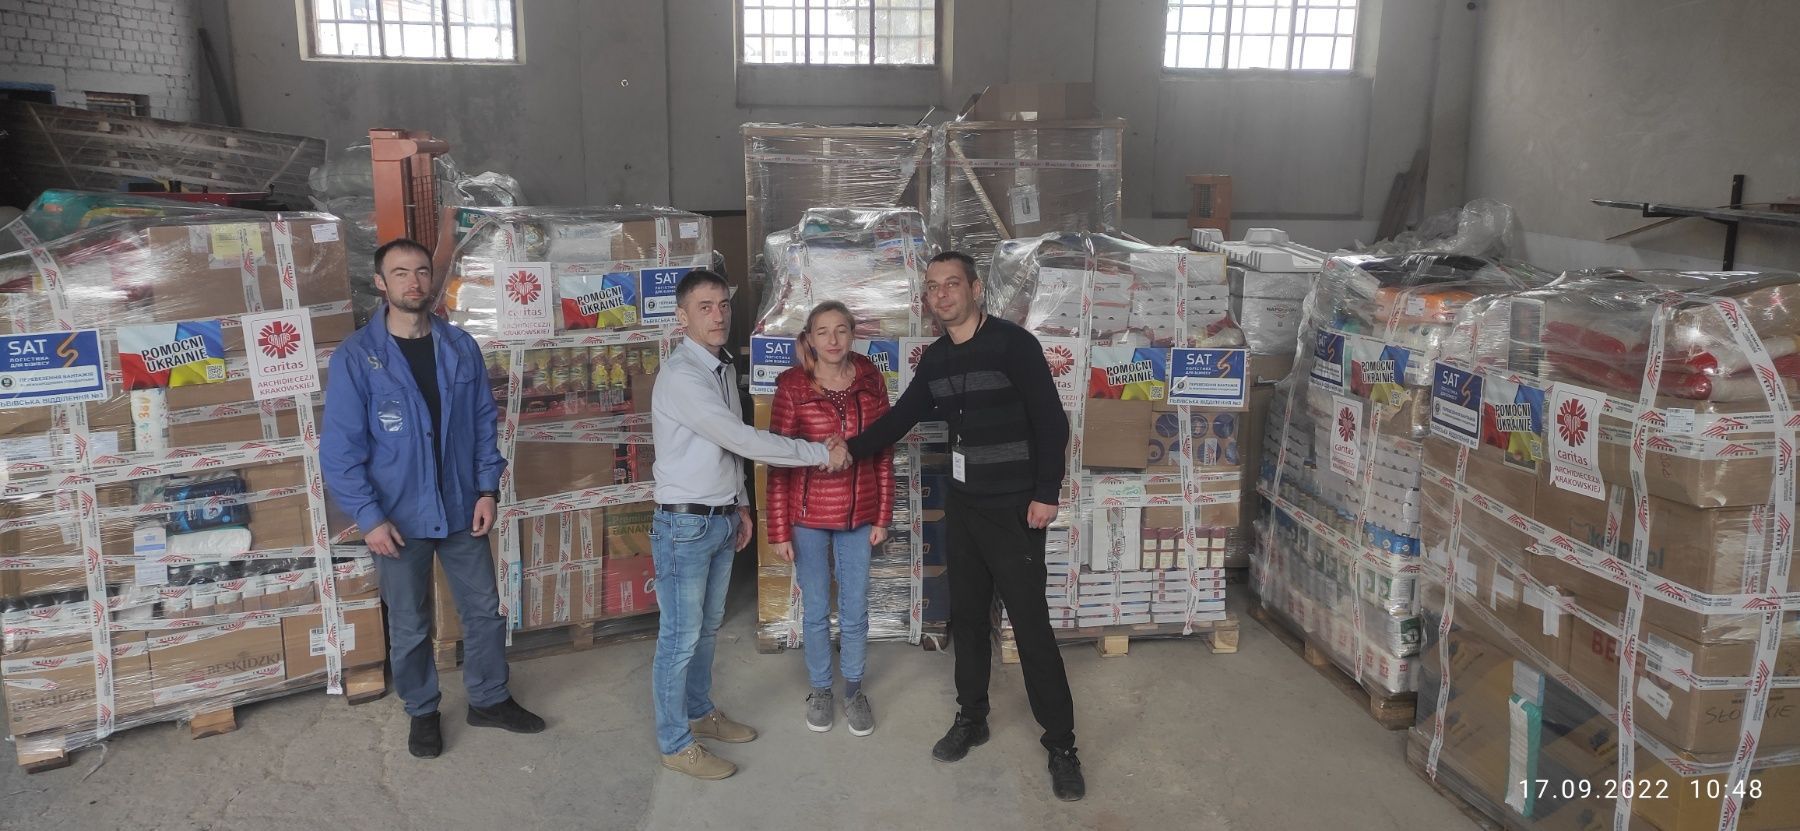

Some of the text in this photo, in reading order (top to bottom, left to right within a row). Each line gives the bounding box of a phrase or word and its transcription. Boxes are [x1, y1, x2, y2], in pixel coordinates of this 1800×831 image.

[655, 272, 679, 285] SAT
[577, 286, 622, 304] POMOCNI
[8, 339, 47, 356] SAT
[141, 336, 204, 360] POMOCNI
[765, 342, 791, 354] SAT
[146, 349, 208, 371] UKRAINIE
[1186, 353, 1213, 365] SAT
[1361, 360, 1394, 371] POMOCNI
[263, 360, 304, 372] caritas
[1106, 361, 1152, 375] POMOCNI
[1362, 372, 1395, 383] UKRAINIE
[1442, 370, 1460, 388] SAT
[0, 399, 41, 407] ЬВІВСЬКА
[1495, 404, 1530, 416] POMOCNI
[1496, 418, 1532, 431] UKRAINIE
[1557, 449, 1588, 466] caritas
[1555, 476, 1601, 493] KRAKOWSKIEJ
